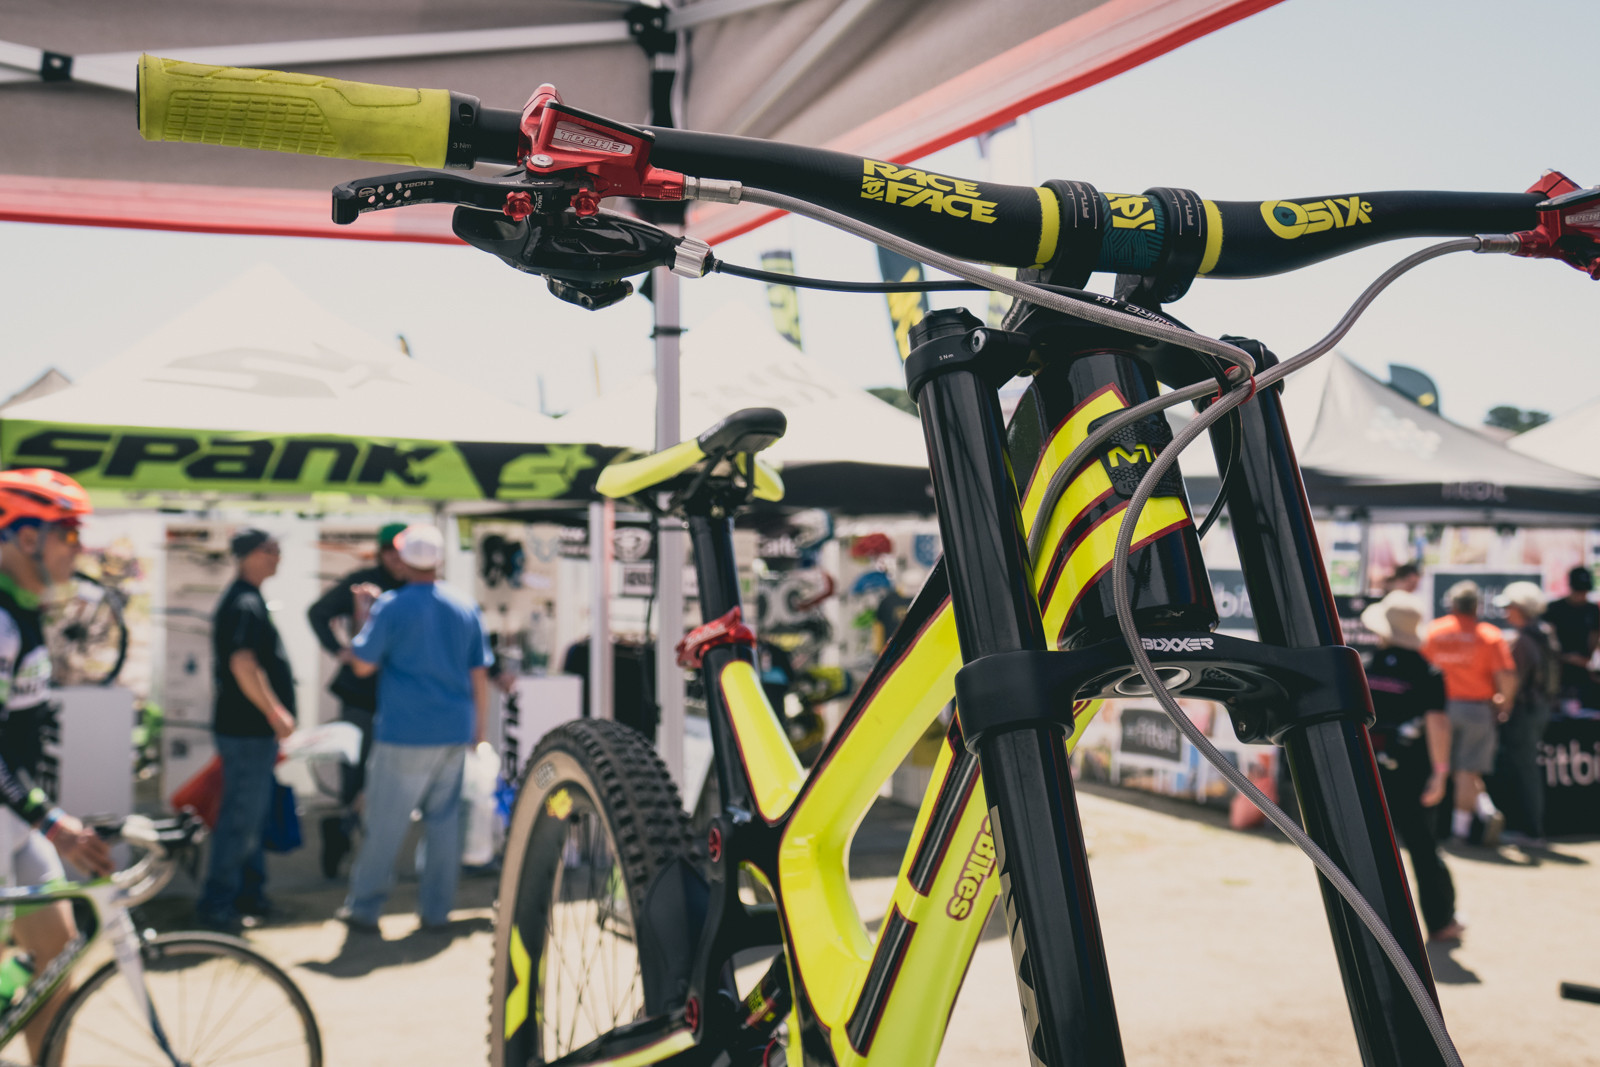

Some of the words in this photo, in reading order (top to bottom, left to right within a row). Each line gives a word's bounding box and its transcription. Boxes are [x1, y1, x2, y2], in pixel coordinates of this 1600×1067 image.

[863, 158, 982, 198] RACE
[885, 180, 998, 224] FACE
[1140, 637, 1214, 652] BOXXER
